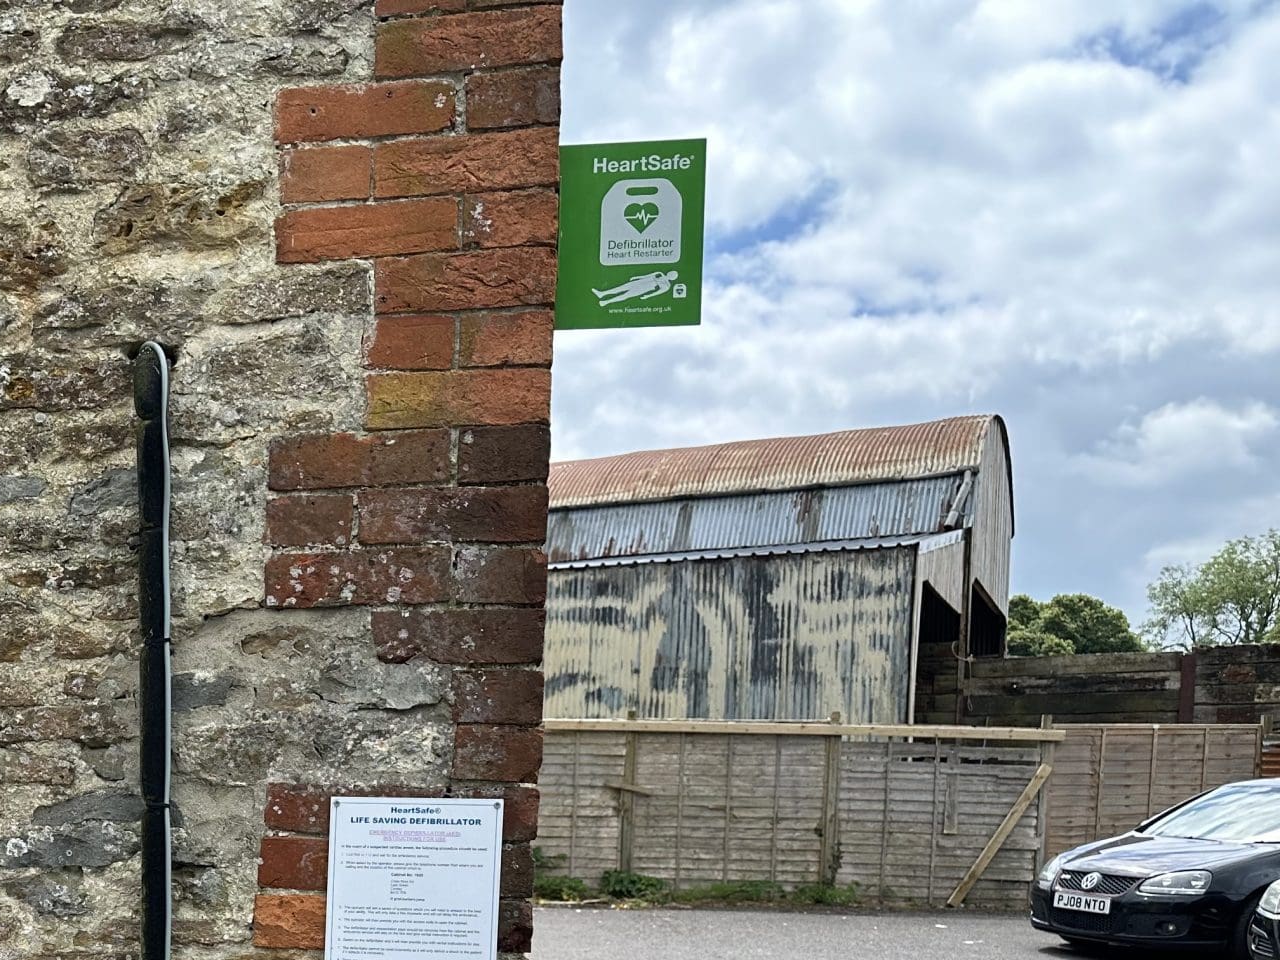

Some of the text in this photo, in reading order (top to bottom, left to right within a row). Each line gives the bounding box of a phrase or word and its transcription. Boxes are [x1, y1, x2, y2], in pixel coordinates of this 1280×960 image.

[608, 239, 674, 250] Defibrillator
[607, 250, 674, 259] Heart Restarter
[608, 306, 671, 314] www.heartsafe.org.uk
[350, 816, 482, 826] LIFE SAVING DEFIBRILLATOR
[1057, 894, 1106, 911] PJ08 NTO
